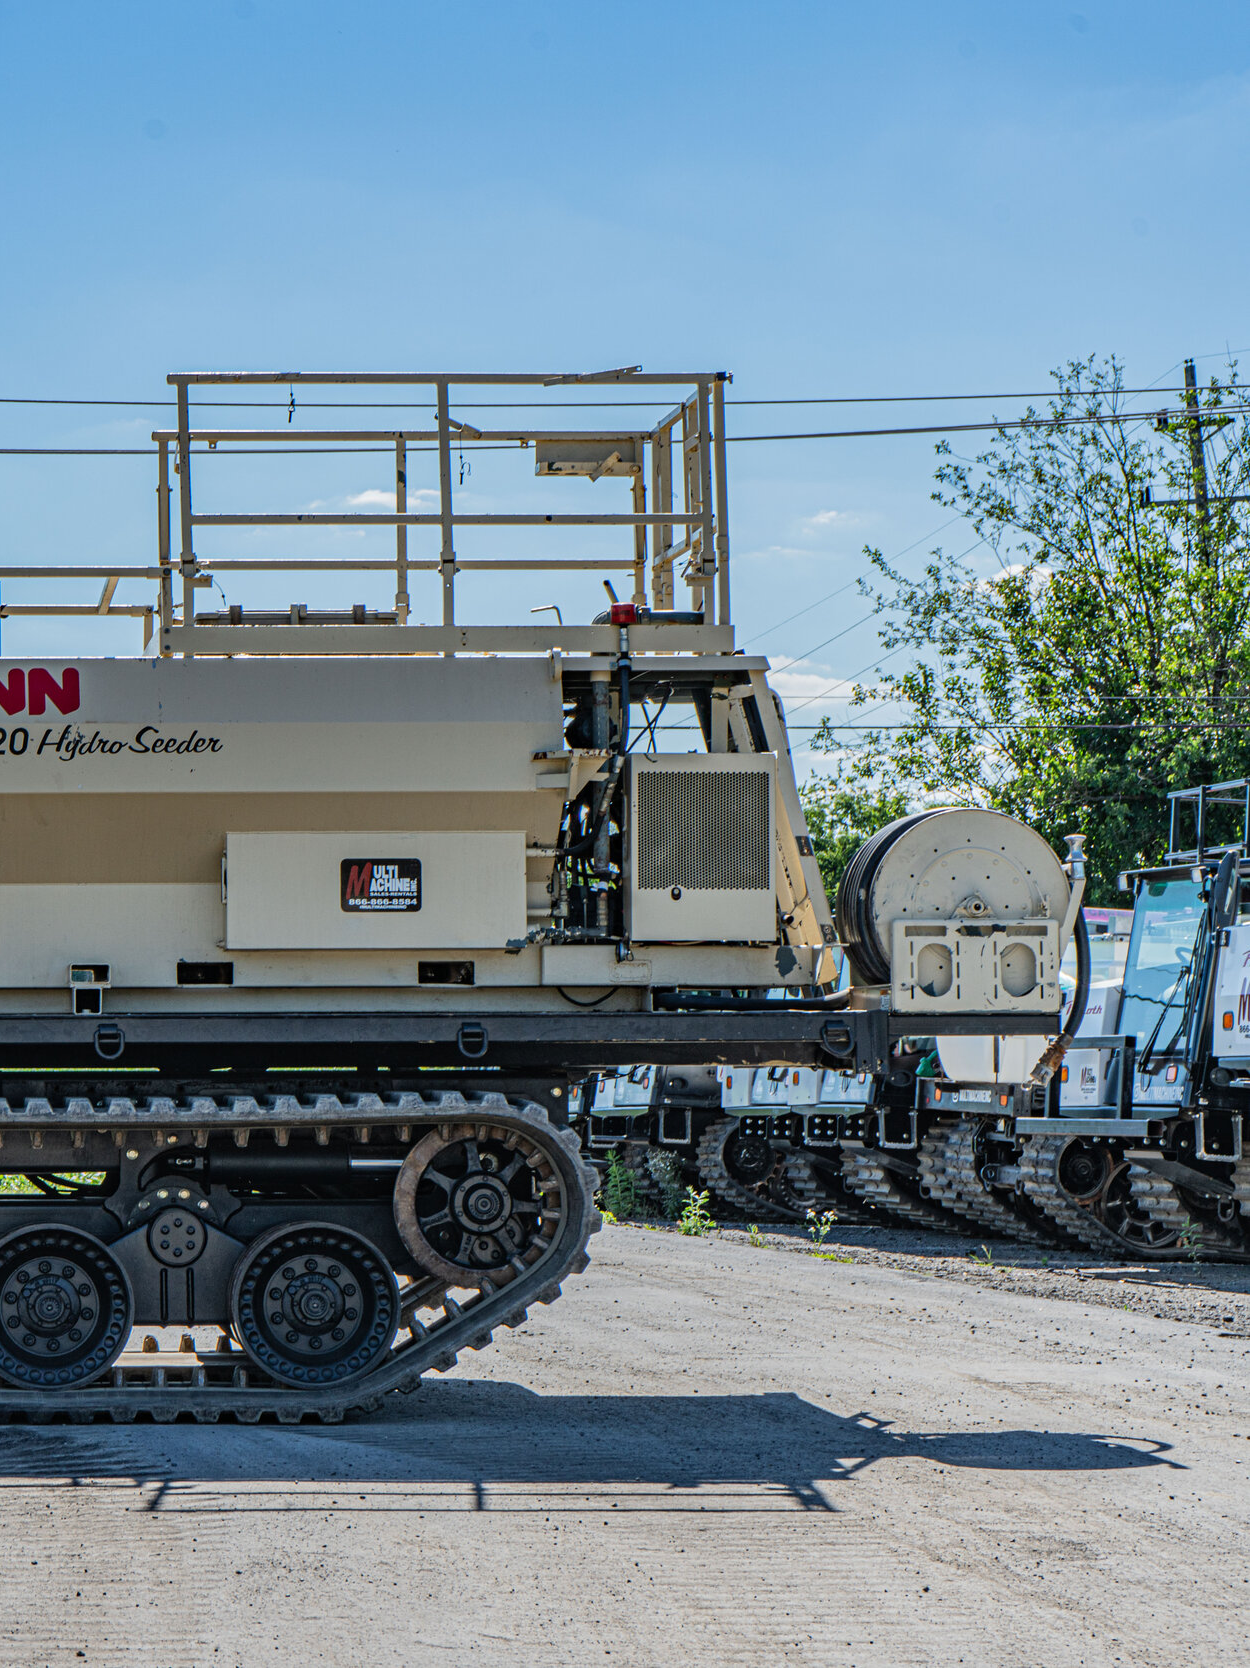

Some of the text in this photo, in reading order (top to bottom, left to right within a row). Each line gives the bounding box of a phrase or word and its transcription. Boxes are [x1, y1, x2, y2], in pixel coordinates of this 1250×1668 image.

[36, 724, 128, 762] Hydro
[128, 726, 224, 755] Seeder
[348, 898, 418, 906] 866-866-8584
